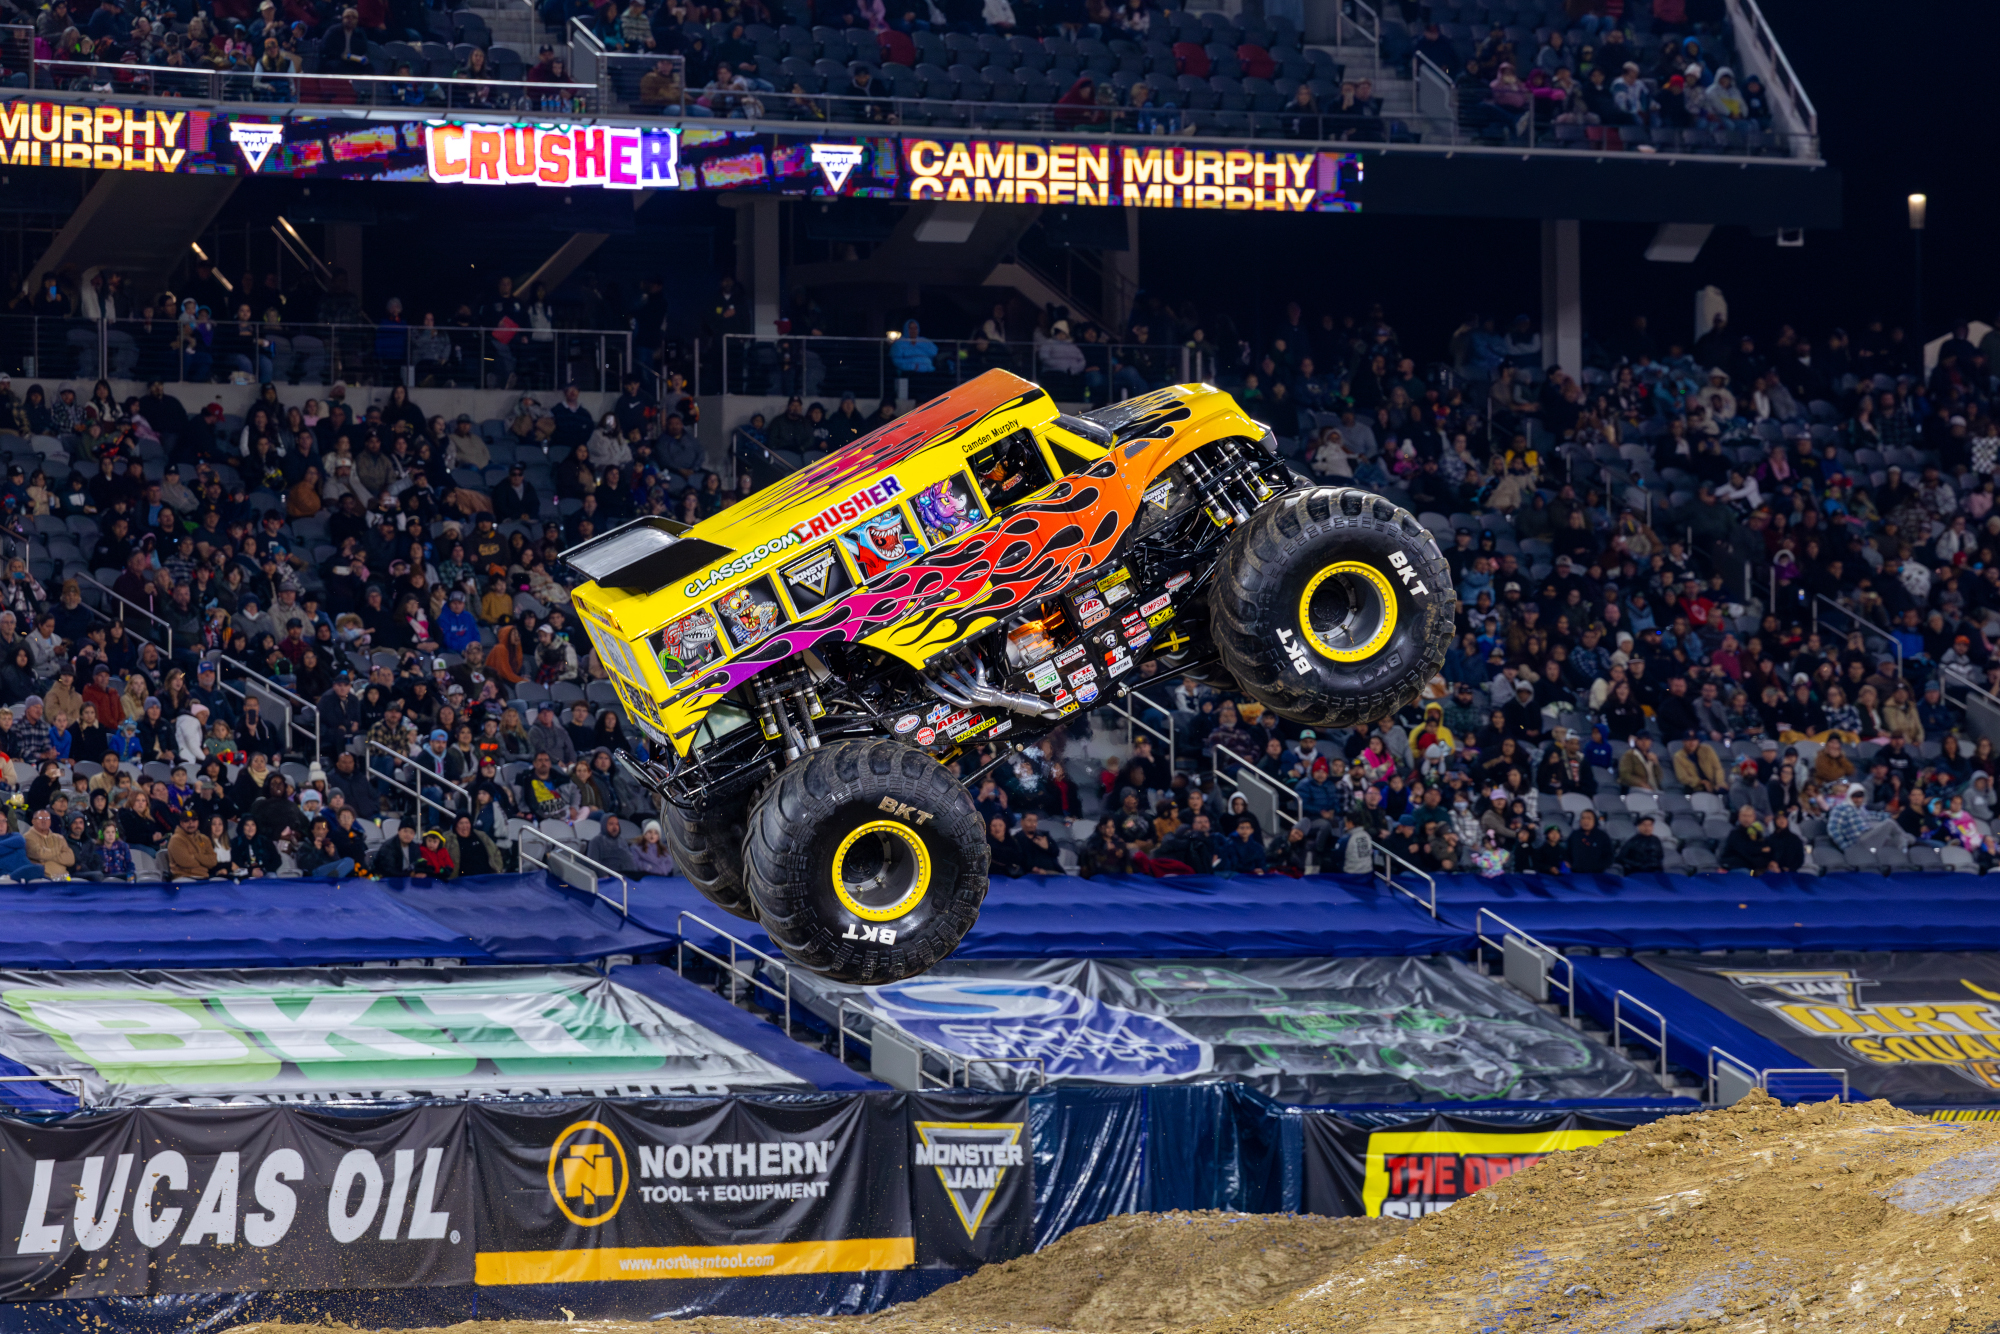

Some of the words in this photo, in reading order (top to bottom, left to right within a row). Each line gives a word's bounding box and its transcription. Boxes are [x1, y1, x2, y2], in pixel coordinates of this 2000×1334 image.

[430, 125, 675, 186] CRUSHER
[910, 140, 1109, 183] CAMDEN
[1122, 147, 1315, 188] MURPHY
[961, 433, 992, 454] Camden
[991, 418, 1020, 438] Murphy
[684, 531, 801, 598] CLASSROOM
[790, 474, 905, 545] CRUSHER
[788, 556, 837, 587] MONSTER
[804, 569, 827, 586] JAM
[1388, 550, 1429, 597] BKT
[1080, 598, 1100, 614] JAZ
[1122, 612, 1139, 625] Coan
[1143, 596, 1168, 615] SIMPSON
[1056, 646, 1080, 663] LINCOLN
[1276, 628, 1312, 675] BKT
[937, 708, 969, 731] ARP
[949, 722, 970, 736] Holley
[956, 718, 996, 742] MAGNAFLOW
[878, 796, 934, 826] BKT
[842, 923, 897, 945] BKT
[15, 994, 630, 1072] BKT
[1850, 1034, 2000, 1068] SQUA
[639, 1141, 829, 1179] NORTHERN
[915, 1143, 1024, 1166] MONSTER
[946, 1167, 995, 1189] JAM
[1387, 1156, 1457, 1195] THE
[17, 1148, 305, 1254] LUCAS
[640, 1185, 693, 1203] TOOL
[713, 1181, 830, 1202] EQUIPMENT
[619, 1253, 775, 1271] www.northerntool.com
